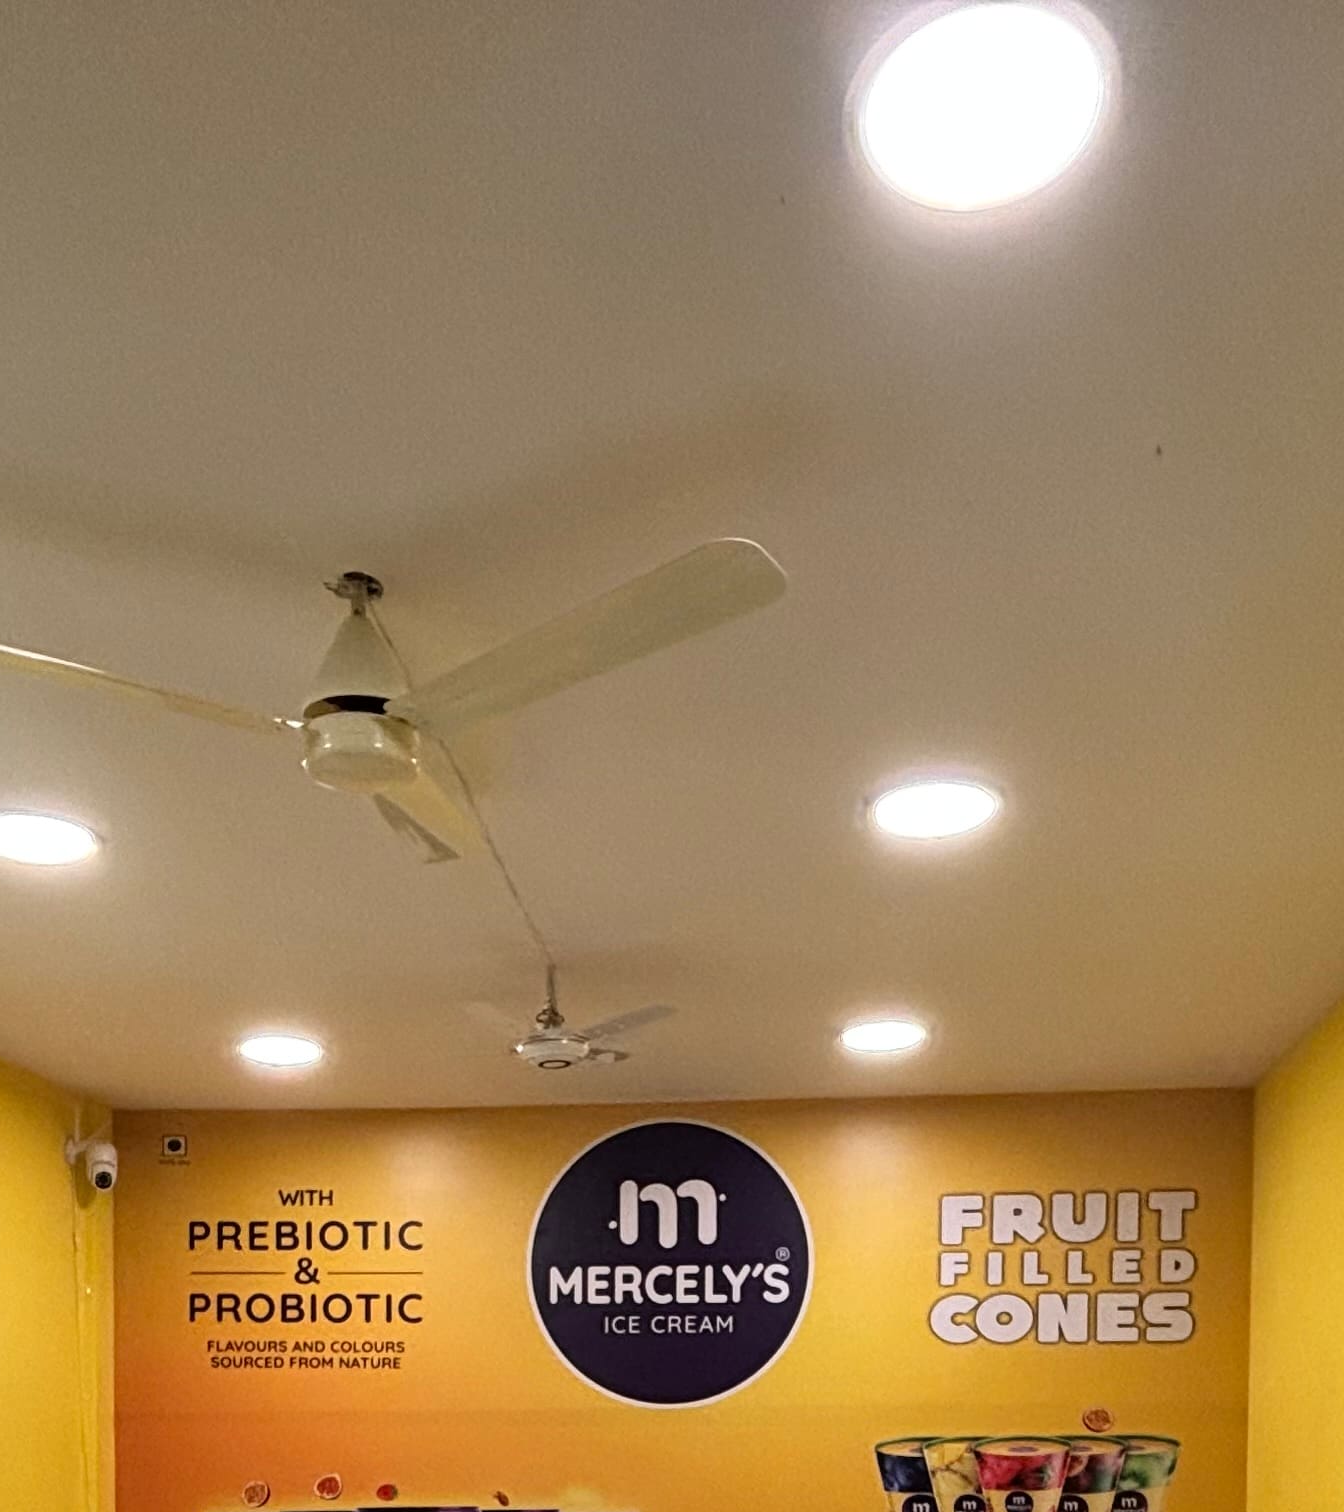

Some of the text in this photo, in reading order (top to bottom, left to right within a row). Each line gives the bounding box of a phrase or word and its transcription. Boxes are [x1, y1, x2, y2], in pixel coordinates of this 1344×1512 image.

[277, 1188, 334, 1207] WITH
[939, 1189, 1197, 1246] FRUIT
[188, 1221, 424, 1251] PREBIOTIC
[293, 1256, 320, 1285] &
[938, 1248, 1197, 1287] FILLED
[549, 1263, 790, 1304] MERCELY'S
[188, 1293, 424, 1323] PROBIOTIC
[928, 1290, 1196, 1345] CONES
[604, 1315, 734, 1333] ICE CREAM
[207, 1341, 405, 1353] FLAVOURS AND COLOURS
[210, 1357, 401, 1369] SOURCED FROM NATURE
